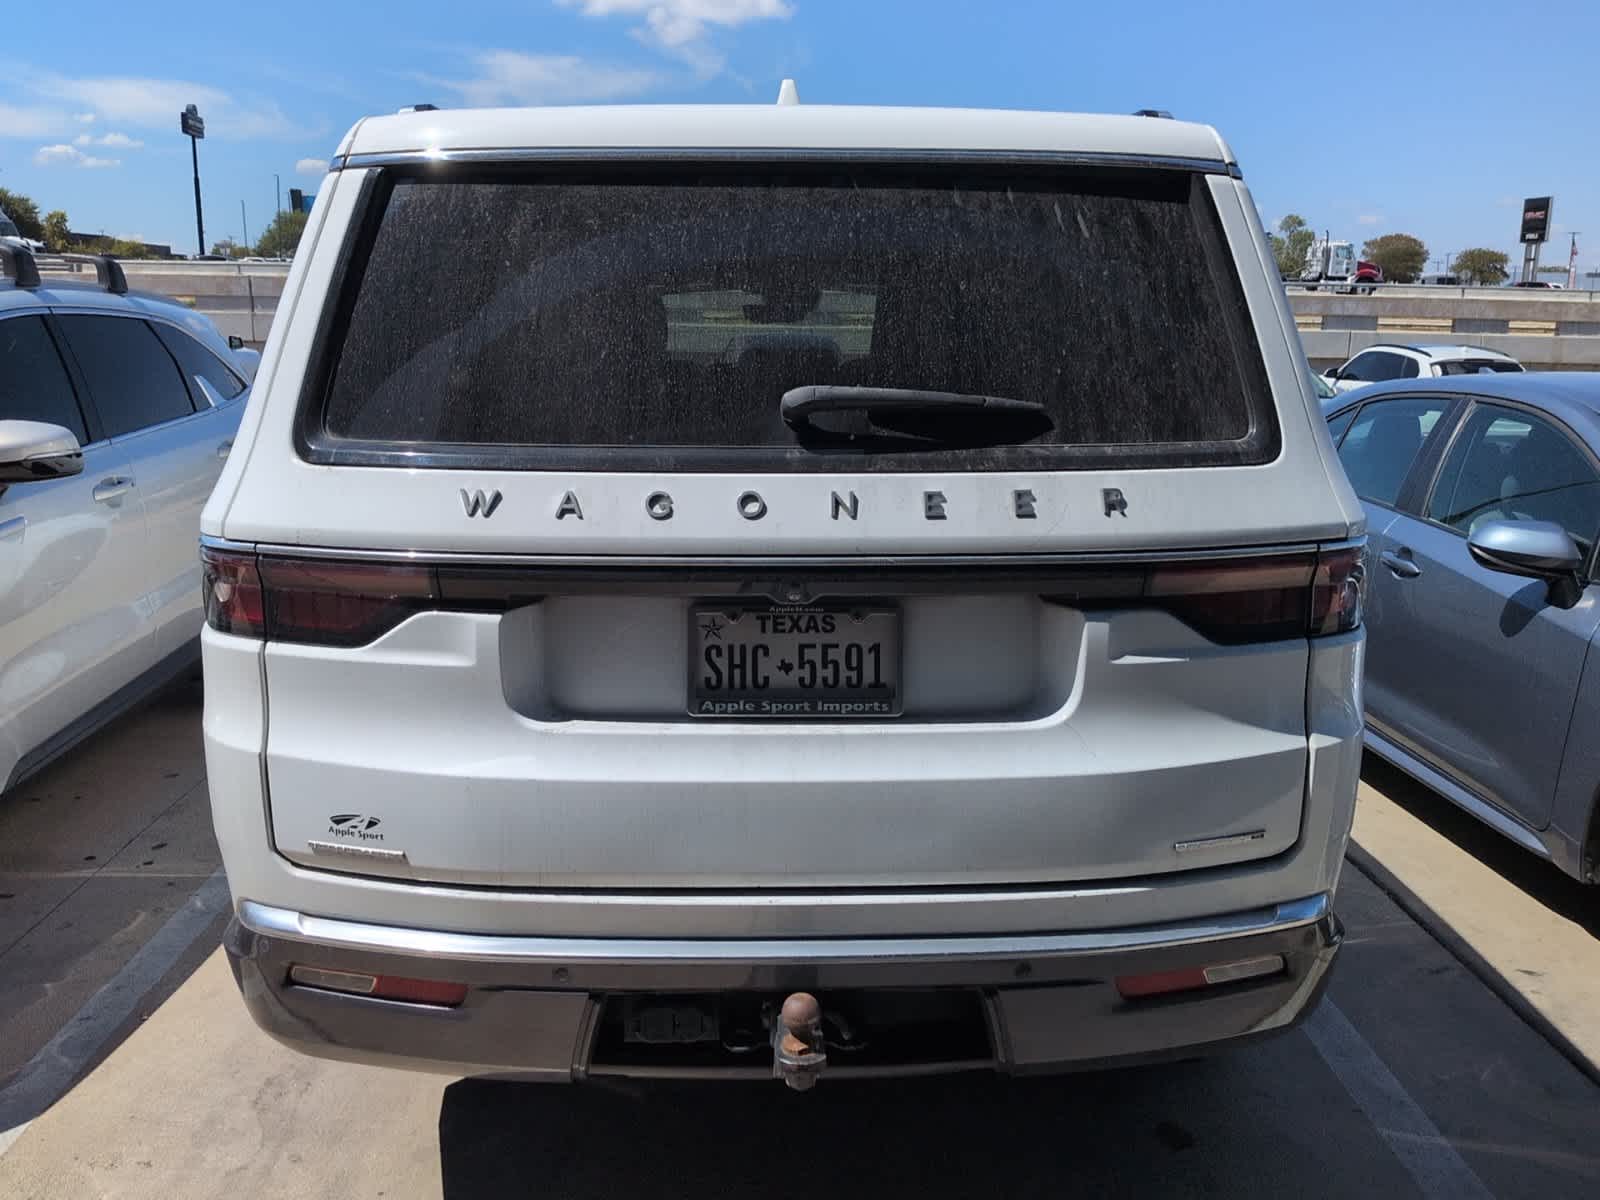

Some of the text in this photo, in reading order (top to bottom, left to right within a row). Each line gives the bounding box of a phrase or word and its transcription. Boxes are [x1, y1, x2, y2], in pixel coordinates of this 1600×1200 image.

[460, 488, 1128, 520] WAGONEER
[756, 614, 836, 634] TEXAS
[704, 642, 888, 691] SHC 5591
[702, 700, 889, 714] Apple Sport Imports
[328, 826, 384, 840] Apple Sport
